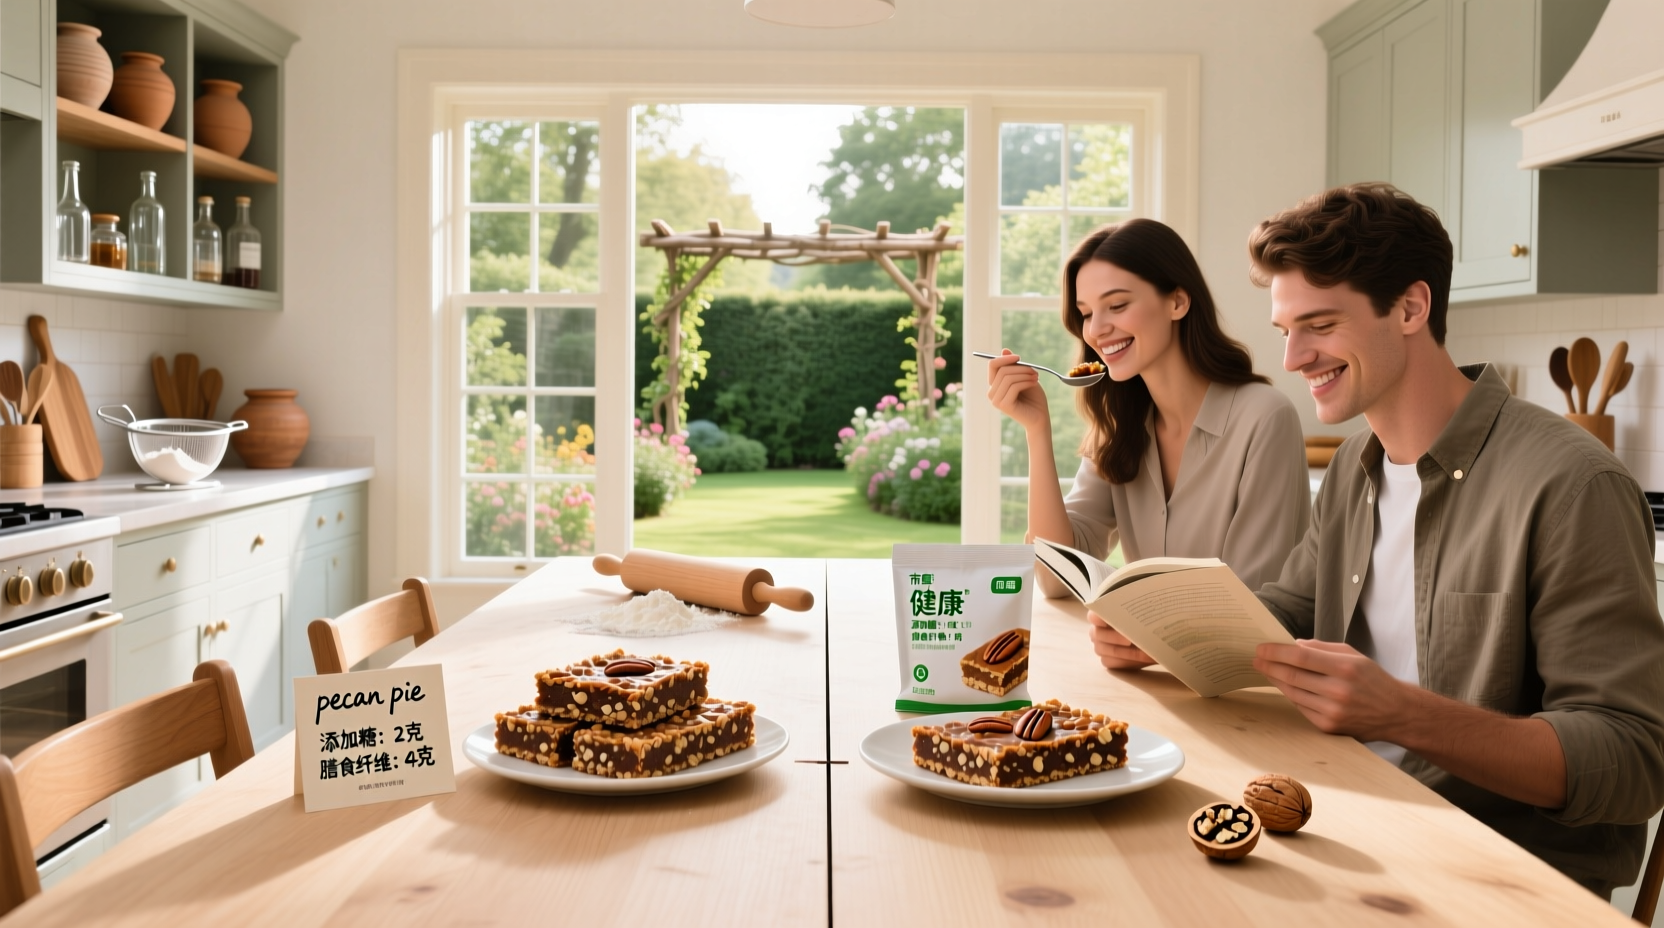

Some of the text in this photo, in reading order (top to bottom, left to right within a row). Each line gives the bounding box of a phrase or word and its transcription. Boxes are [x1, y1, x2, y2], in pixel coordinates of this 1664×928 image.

[910, 586, 965, 617] 健康
[315, 681, 426, 726] pecan pie
